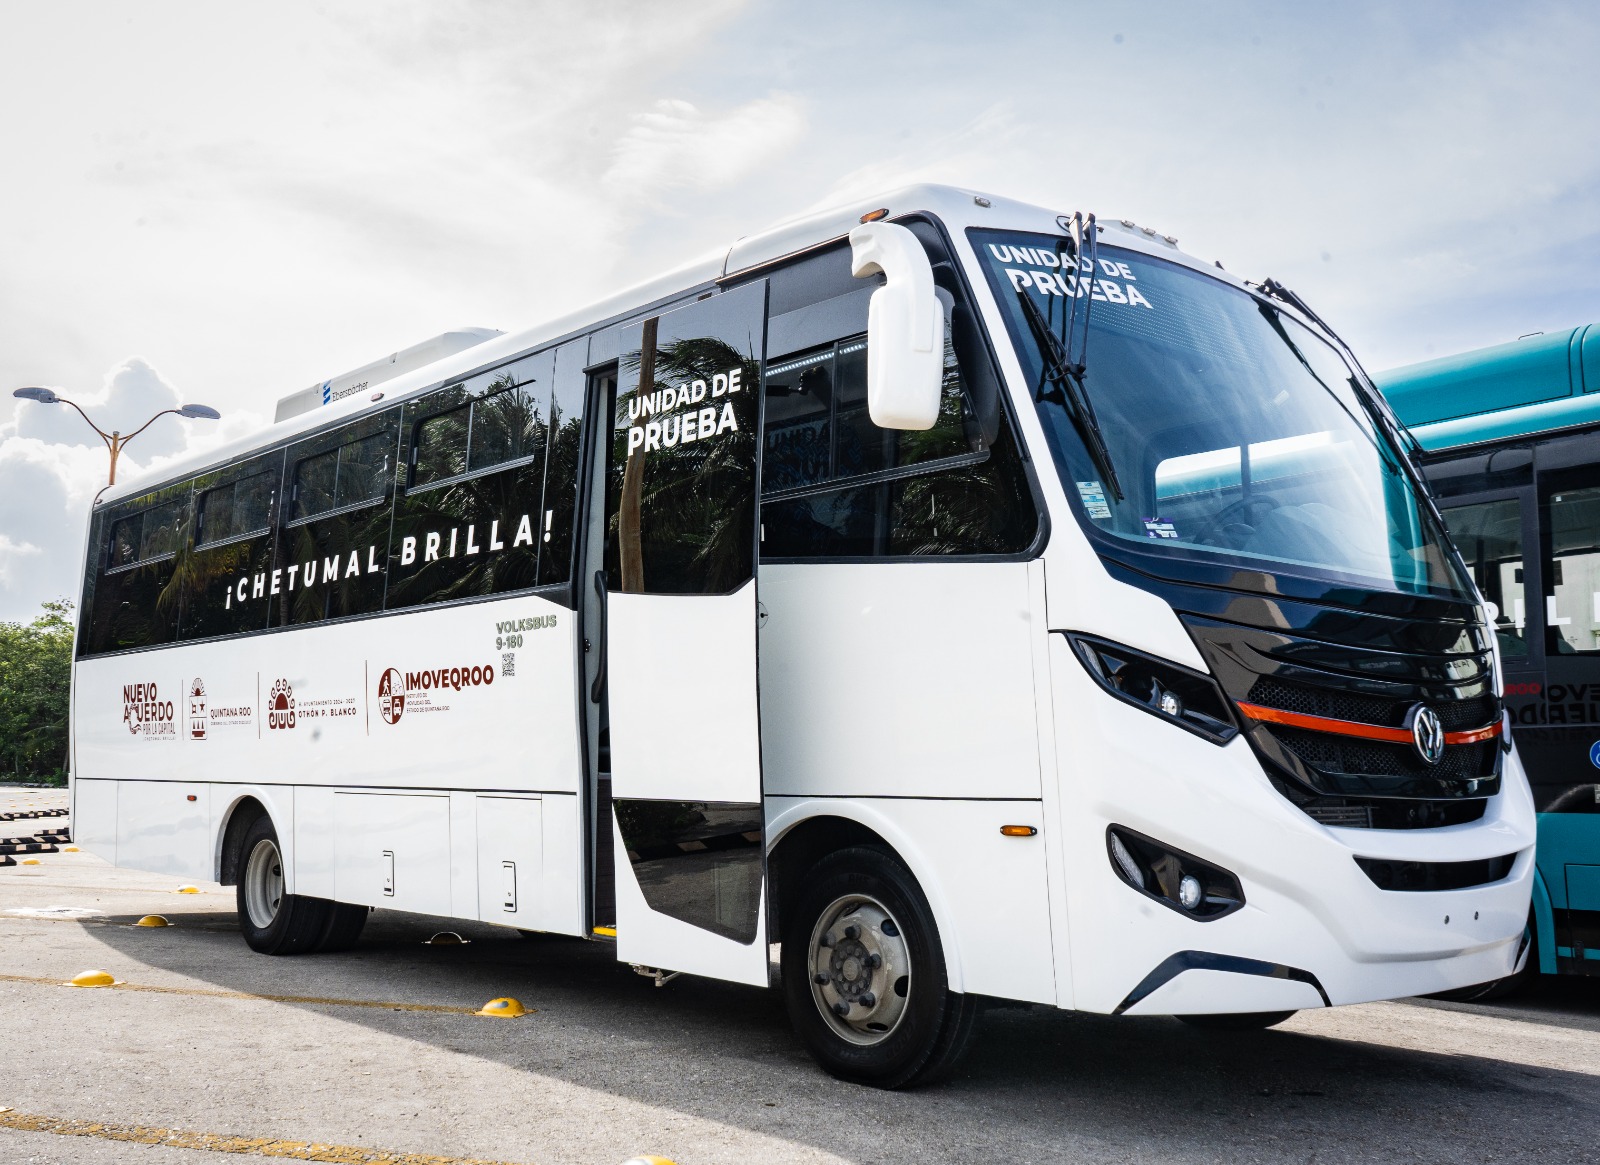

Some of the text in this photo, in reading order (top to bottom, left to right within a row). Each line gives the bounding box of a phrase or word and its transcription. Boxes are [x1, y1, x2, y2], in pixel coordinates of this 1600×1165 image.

[988, 243, 1137, 281] UNIDAD DE
[1004, 268, 1154, 309] PRUEBA
[628, 367, 742, 420] UNIDAD DE
[627, 401, 738, 457] PRUEBA
[224, 509, 554, 610] ¡CHETUMAL BRILLA!
[495, 614, 557, 634] VOLKSBUS
[495, 634, 524, 651] 9-180
[405, 664, 495, 692] IMOVEQROO
[123, 682, 157, 704] NUEVO
[210, 706, 252, 719] QUINTANA ROO
[330, 707, 357, 717] BLANCO
